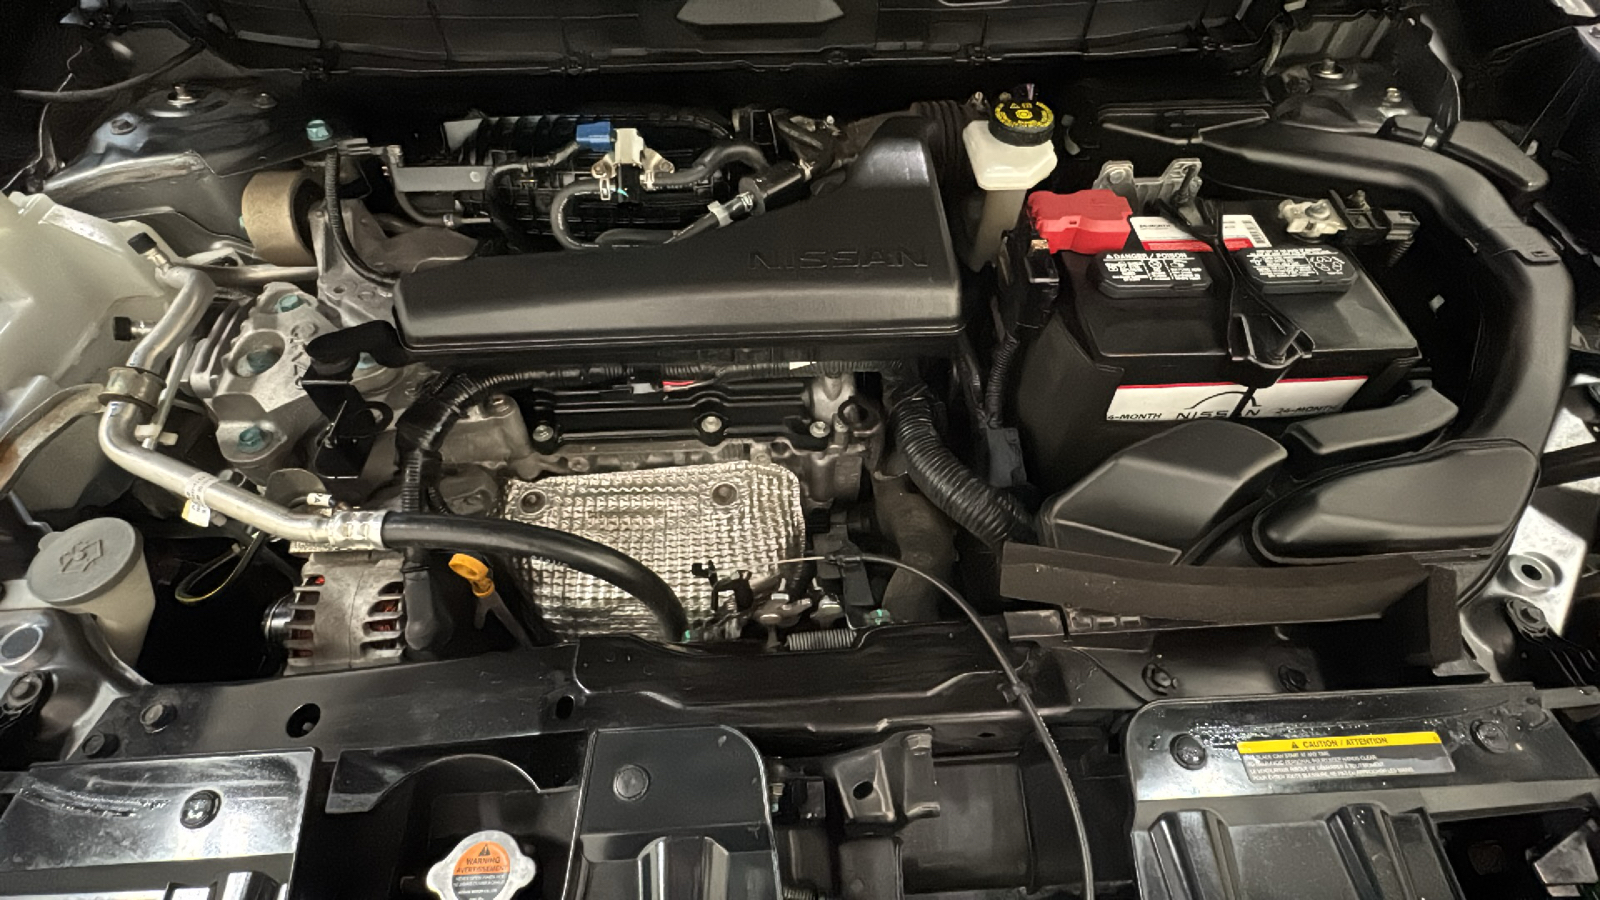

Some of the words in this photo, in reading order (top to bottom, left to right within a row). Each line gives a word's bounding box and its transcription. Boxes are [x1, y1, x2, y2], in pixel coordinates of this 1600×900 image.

[750, 251, 928, 269] NISSAN
[1175, 409, 1261, 419] NISSN
[1302, 739, 1338, 749] CAUTION
[1346, 737, 1388, 746] ATTENTION
[466, 857, 501, 866] WARNING
